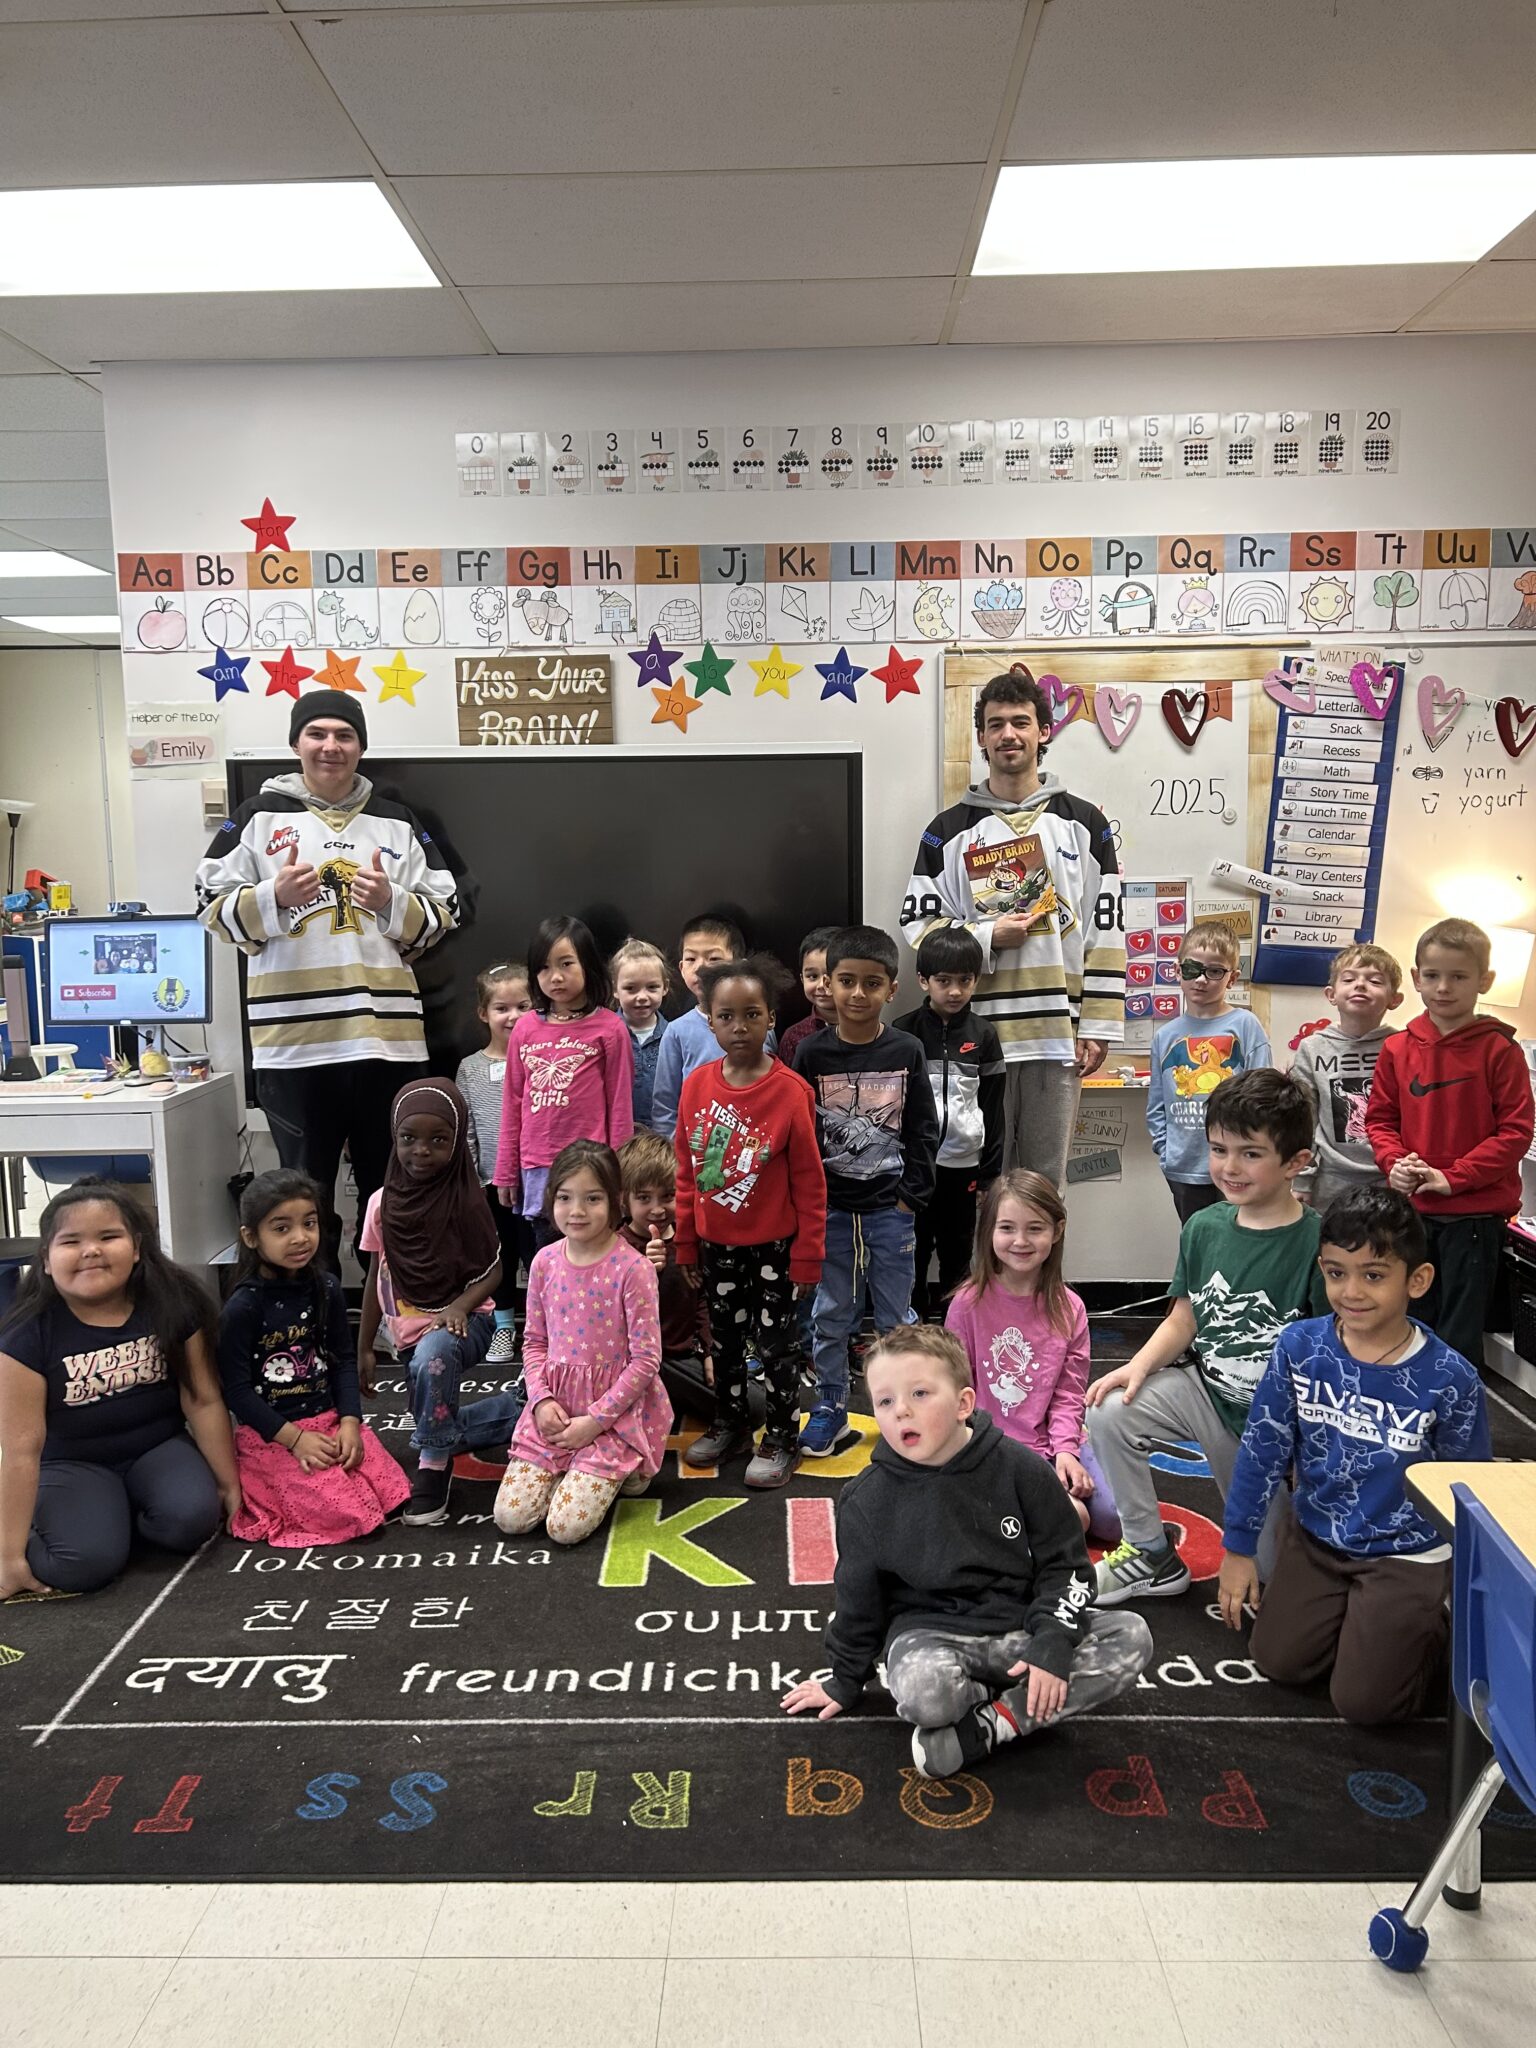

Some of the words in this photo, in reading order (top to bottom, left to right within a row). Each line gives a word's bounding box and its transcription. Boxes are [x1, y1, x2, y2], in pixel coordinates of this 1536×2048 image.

[1054, 420, 1069, 439] 13
[1099, 419, 1113, 437] 14
[1143, 418, 1158, 436] 15
[1188, 416, 1204, 434] 16
[1234, 415, 1250, 433] 17
[1279, 414, 1294, 432] 18
[1325, 412, 1340, 431] 19
[1366, 411, 1391, 430] 20
[697, 430, 709, 448] 5
[743, 429, 754, 447] 6
[787, 429, 799, 447] 7
[831, 427, 842, 445] 8
[877, 427, 887, 444] 9
[918, 425, 935, 442] 10
[967, 423, 976, 441] 11
[1010, 422, 1024, 440] 12
[471, 436, 483, 453] 0
[519, 435, 525, 453] 1
[561, 434, 572, 452] 2
[606, 433, 618, 451] 3
[651, 432, 662, 449] 4
[1039, 541, 1080, 572] Oo
[1239, 537, 1275, 568] Rr
[1305, 535, 1341, 566] Ss
[1374, 534, 1407, 564] Tt
[1437, 533, 1476, 563] Uu
[456, 551, 491, 581] Ff
[583, 550, 622, 580] Hh
[656, 548, 679, 579] Ii
[718, 547, 747, 585] Jj
[779, 546, 816, 577] Kk
[850, 545, 876, 575] Ll
[901, 544, 956, 575] Mm
[975, 543, 1013, 574] Nn
[1106, 540, 1143, 577] Pp
[1170, 539, 1217, 576] Qq
[132, 556, 172, 587] Aa
[196, 555, 235, 586] Bb
[260, 554, 299, 584] Cc
[325, 553, 364, 584] Dd
[391, 552, 429, 582] Ee
[519, 550, 559, 588] Gg
[645, 653, 660, 669] a
[1363, 651, 1381, 664] ON
[213, 665, 240, 682] am
[272, 667, 298, 685] the
[761, 667, 786, 682] you
[827, 669, 853, 686] and
[886, 667, 911, 683] we
[664, 696, 684, 716] to
[1318, 700, 1369, 714] Letterlan
[131, 713, 163, 725] Helper
[165, 713, 178, 723] of
[181, 713, 198, 722] the
[199, 712, 220, 724] Day
[1329, 723, 1362, 735] Snack
[161, 741, 206, 760] Emily
[1323, 744, 1361, 756] Recess
[1323, 766, 1350, 777] Math
[1463, 767, 1506, 788] yarn
[1150, 778, 1226, 816] 2025
[1310, 786, 1342, 799] Story
[1343, 788, 1369, 800] Time
[1459, 783, 1528, 816] yogurt
[1304, 806, 1336, 818] Lunch
[1341, 808, 1367, 820] Time
[1307, 828, 1356, 840] Calendar
[323, 841, 355, 850] CCM
[972, 849, 1004, 867] BRADY
[1004, 841, 1036, 858] BRADY
[1304, 847, 1332, 861] Gym
[1248, 875, 1273, 891] Rece
[1295, 869, 1318, 883] Play
[1321, 871, 1362, 883] Centers
[1312, 890, 1344, 902] Snack
[1169, 908, 1175, 918] 1
[1305, 911, 1342, 924] Library
[1138, 938, 1145, 947] 7
[1167, 941, 1176, 950] 8
[1294, 931, 1319, 942] Pack
[1322, 932, 1337, 944] Up
[1134, 969, 1146, 979] 14
[1164, 968, 1176, 977] 15
[78, 987, 112, 997] Subscribe
[1132, 1001, 1144, 1011] 21
[1159, 1001, 1174, 1010] 22
[228, 1542, 553, 1574] lokomaika
[242, 1597, 474, 1632] 친절한
[125, 1654, 347, 1704] दयालु
